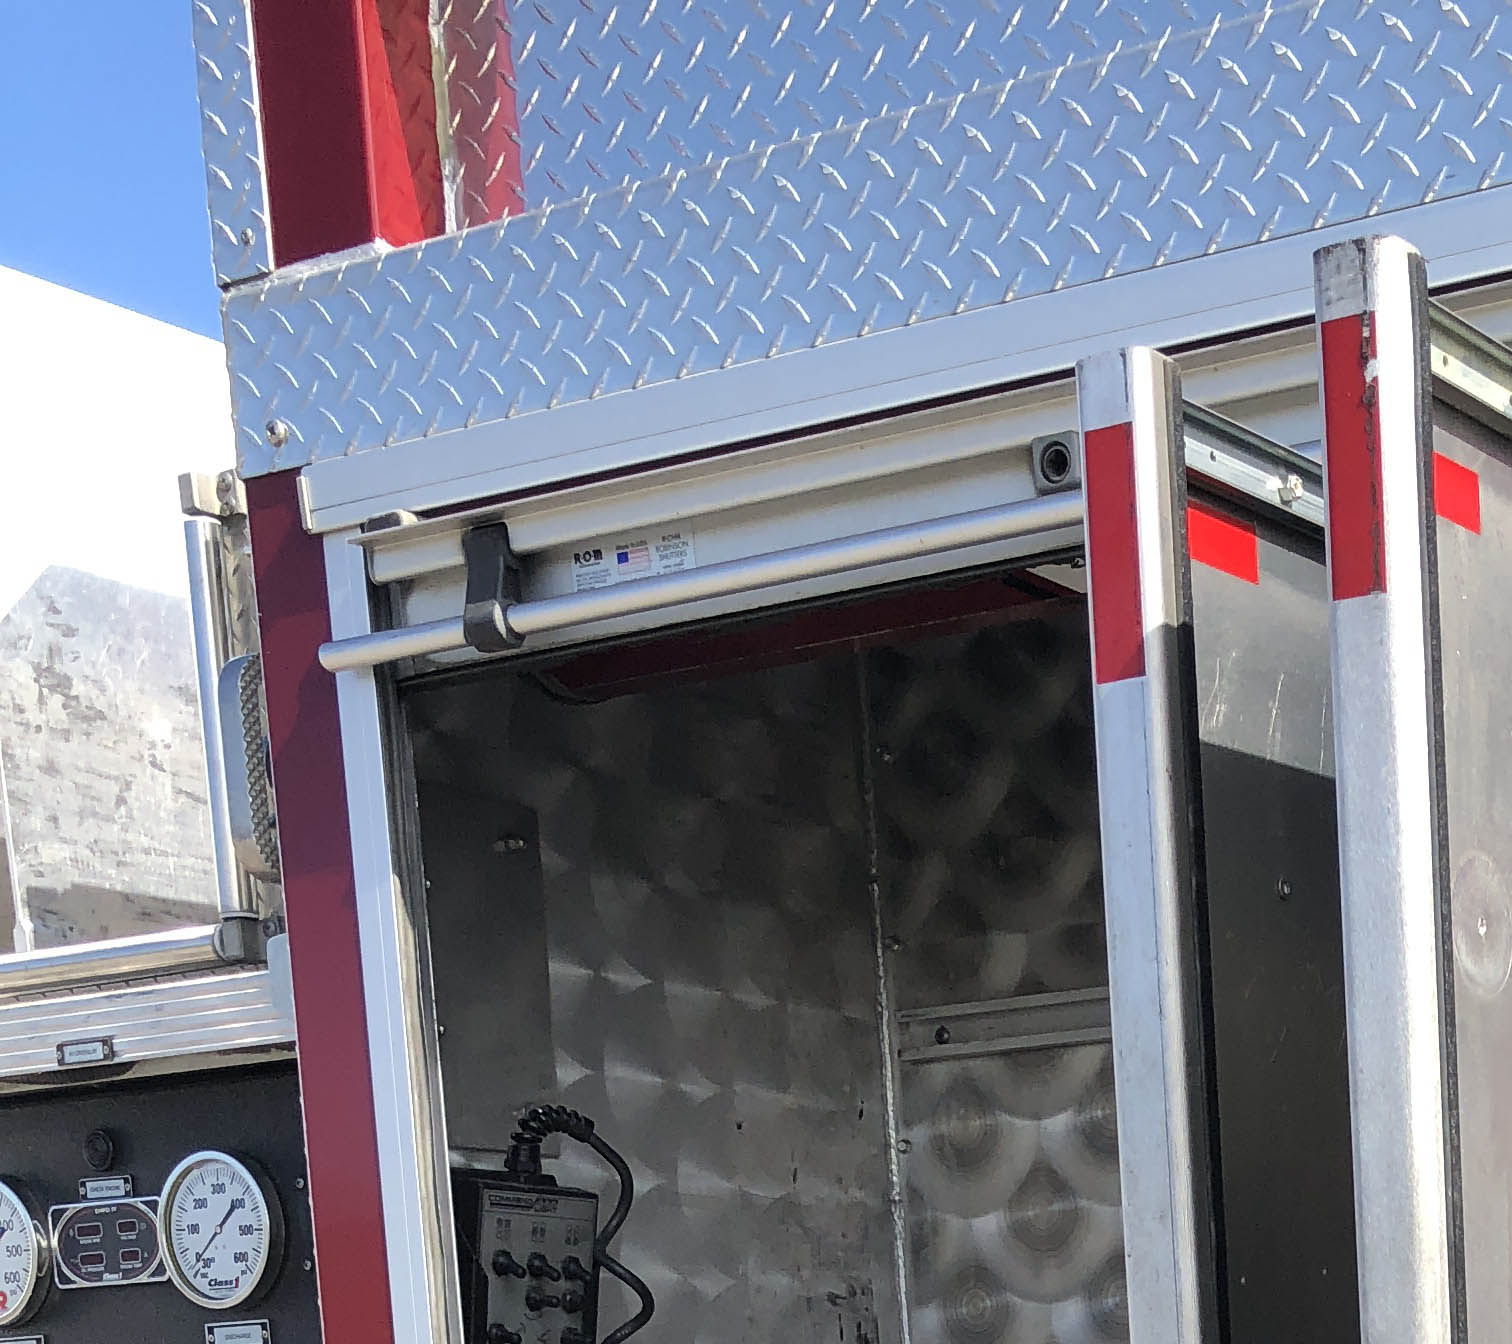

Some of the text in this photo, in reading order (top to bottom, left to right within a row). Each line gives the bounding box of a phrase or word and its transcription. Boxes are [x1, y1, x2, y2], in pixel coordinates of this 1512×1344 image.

[211, 1183, 226, 1195] 300
[193, 1198, 208, 1210] 200
[186, 1224, 254, 1236] 100 500
[6, 1245, 22, 1257] 500
[233, 1252, 249, 1263] 600
[4, 1271, 21, 1284] 600
